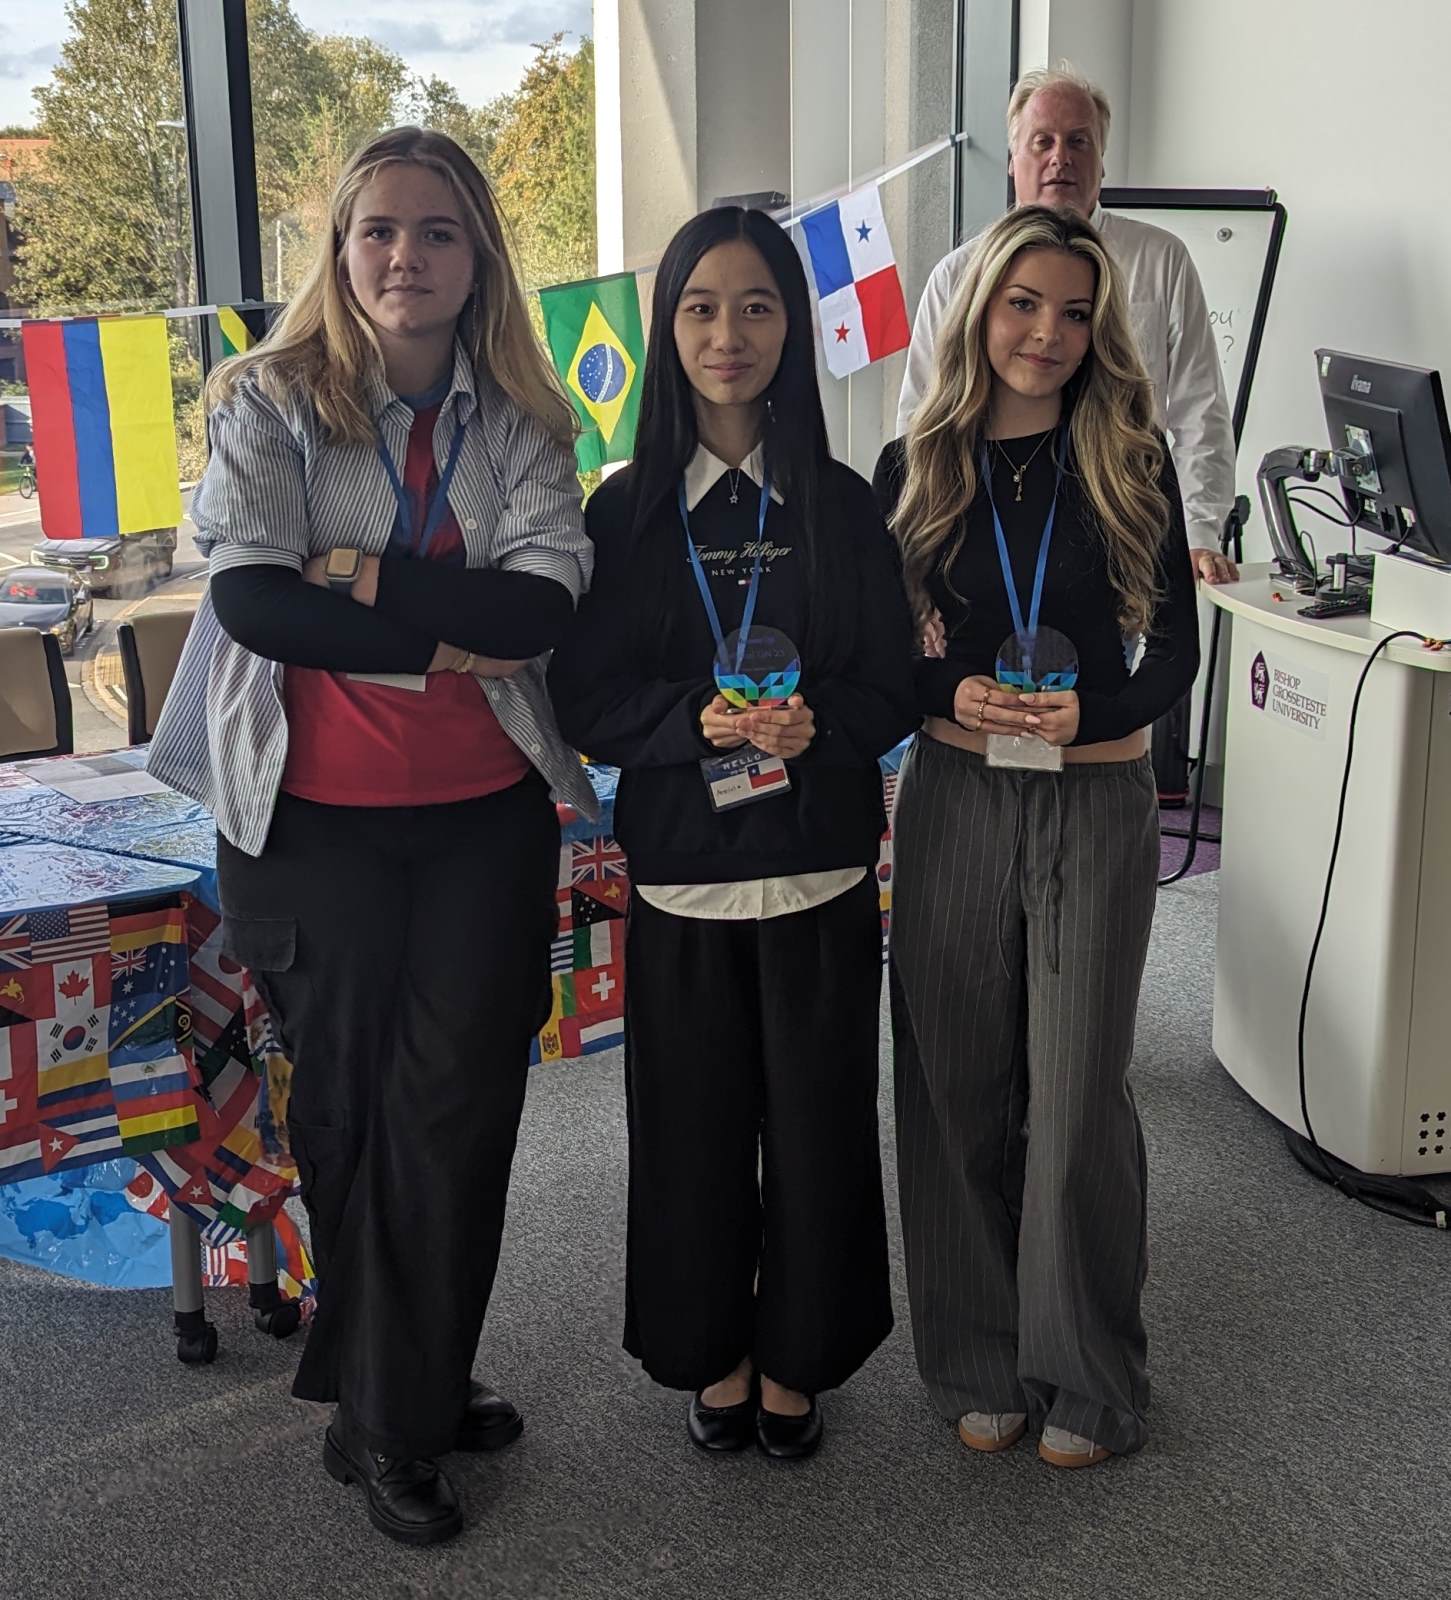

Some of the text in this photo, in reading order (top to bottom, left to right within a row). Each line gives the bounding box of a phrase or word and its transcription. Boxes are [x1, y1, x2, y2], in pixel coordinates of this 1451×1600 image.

[1208, 310, 1233, 328] ou
[686, 544, 738, 565] Tommy
[711, 568, 736, 576] NEW
[1273, 668, 1301, 690] BISHOP
[1272, 684, 1327, 716] GROSSETESTE
[1272, 699, 1321, 730] UNIVERSITY
[721, 752, 761, 770] HELLO
